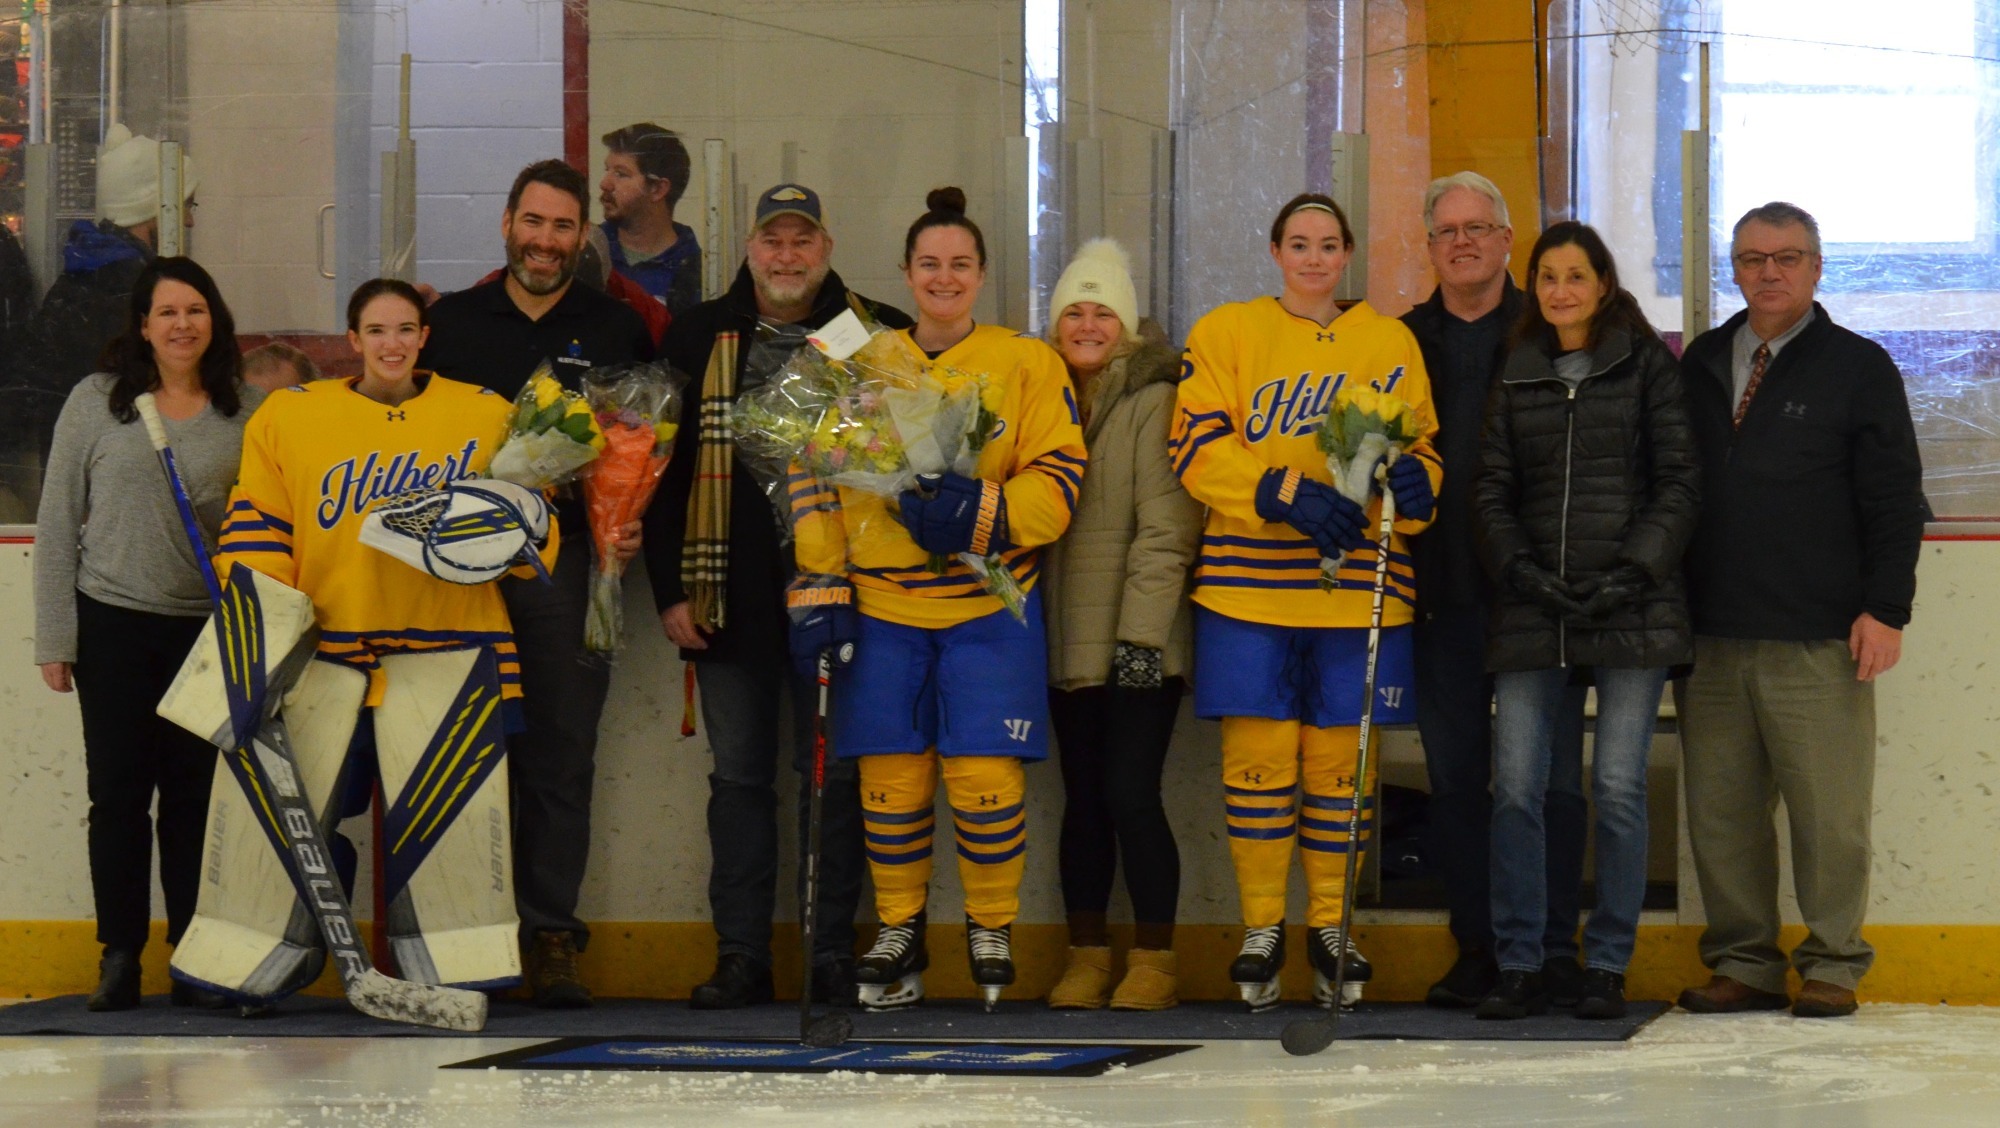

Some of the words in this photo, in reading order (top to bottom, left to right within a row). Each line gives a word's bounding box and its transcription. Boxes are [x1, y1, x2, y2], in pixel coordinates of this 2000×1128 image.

[317, 438, 479, 530] Hilbert
[969, 479, 1000, 557] WARRIOR
[284, 807, 366, 981] BAUER
[489, 806, 504, 894] BAUER
